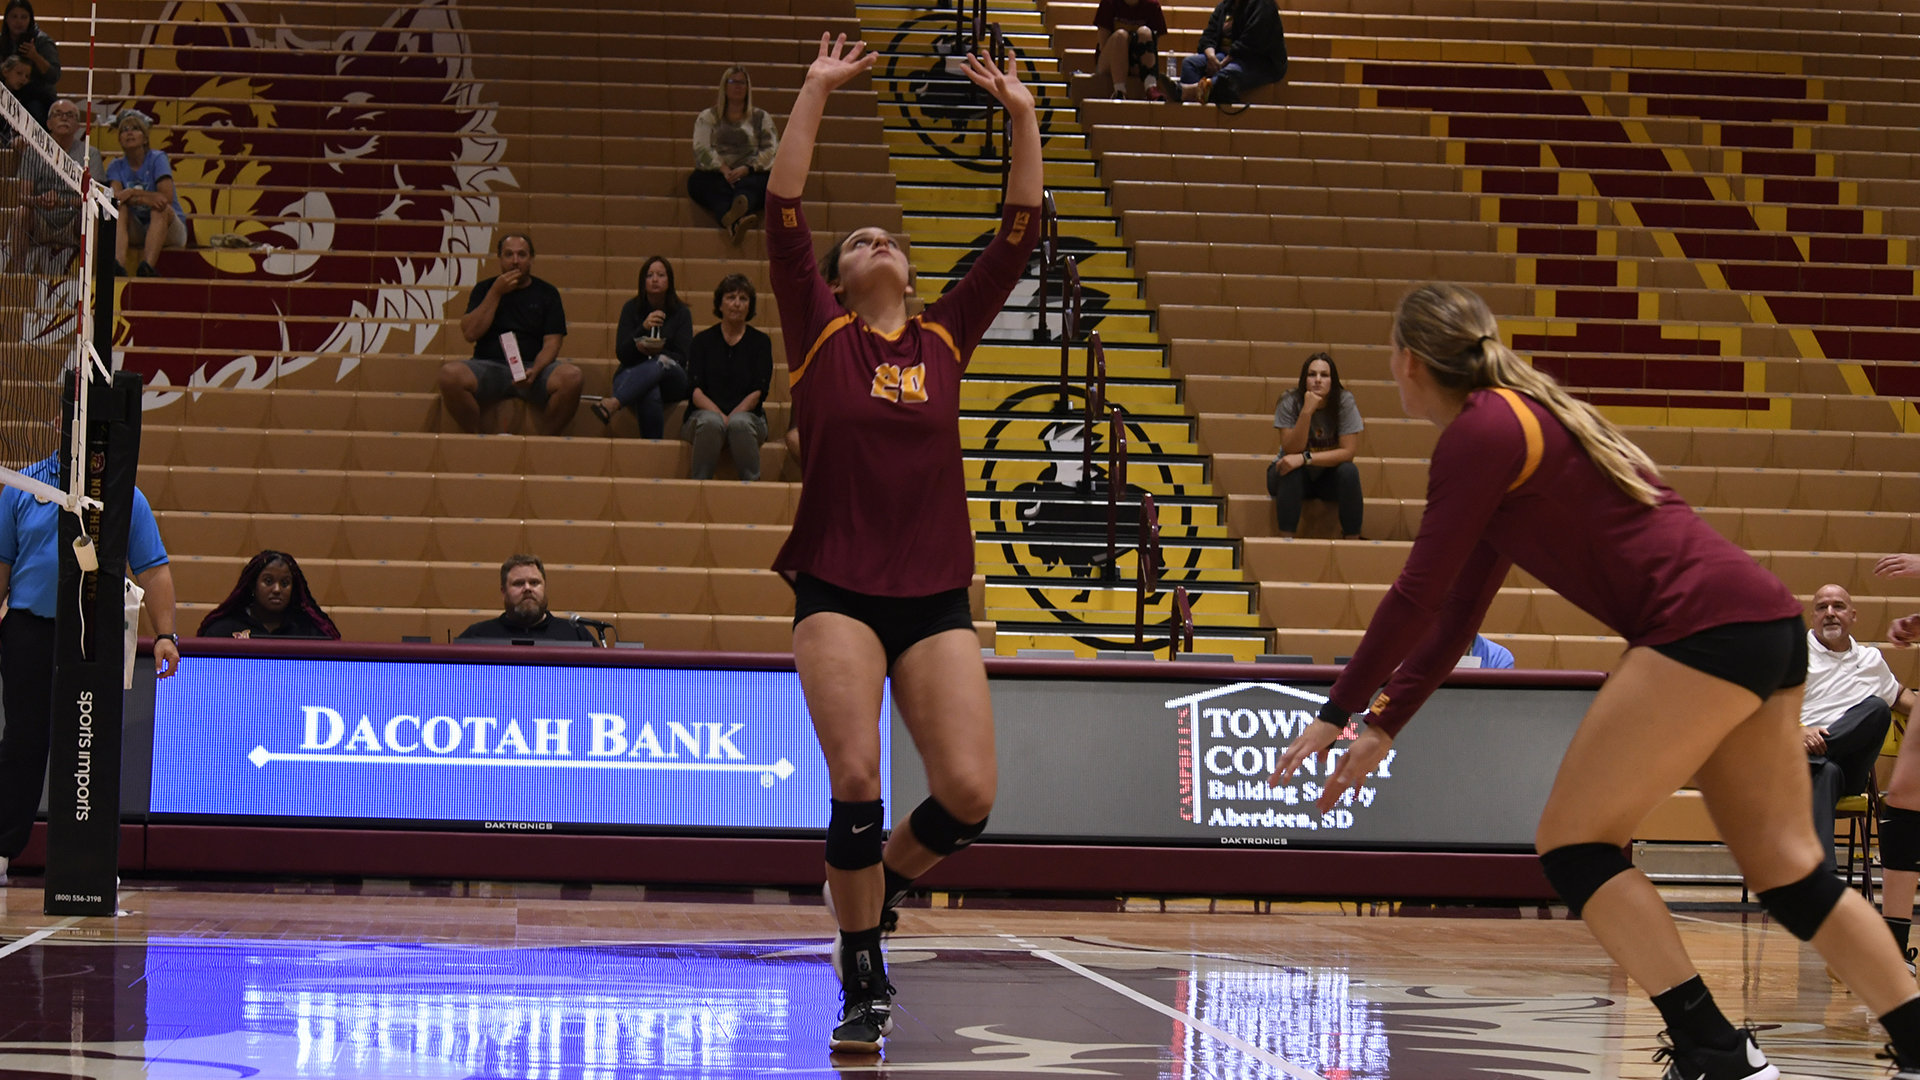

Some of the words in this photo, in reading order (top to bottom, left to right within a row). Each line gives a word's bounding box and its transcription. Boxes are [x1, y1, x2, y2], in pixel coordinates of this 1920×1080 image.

[870, 362, 928, 403] 20
[77, 691, 94, 748] sports
[300, 705, 573, 756] DACOTAH
[587, 712, 746, 760] BANK
[1203, 707, 1320, 739] TOWN
[1204, 745, 1397, 778] COUNTY
[74, 751, 91, 821] imports
[1207, 779, 1299, 805] Building
[1302, 780, 1376, 807] Suply
[485, 821, 553, 830] DAKTRONICS
[1208, 807, 1318, 831] Aberdeen,
[1321, 808, 1354, 829] SD
[1220, 836, 1288, 846] DAKTRONICS
[55, 893, 71, 902] (800)
[72, 894, 102, 903] 556-3198
